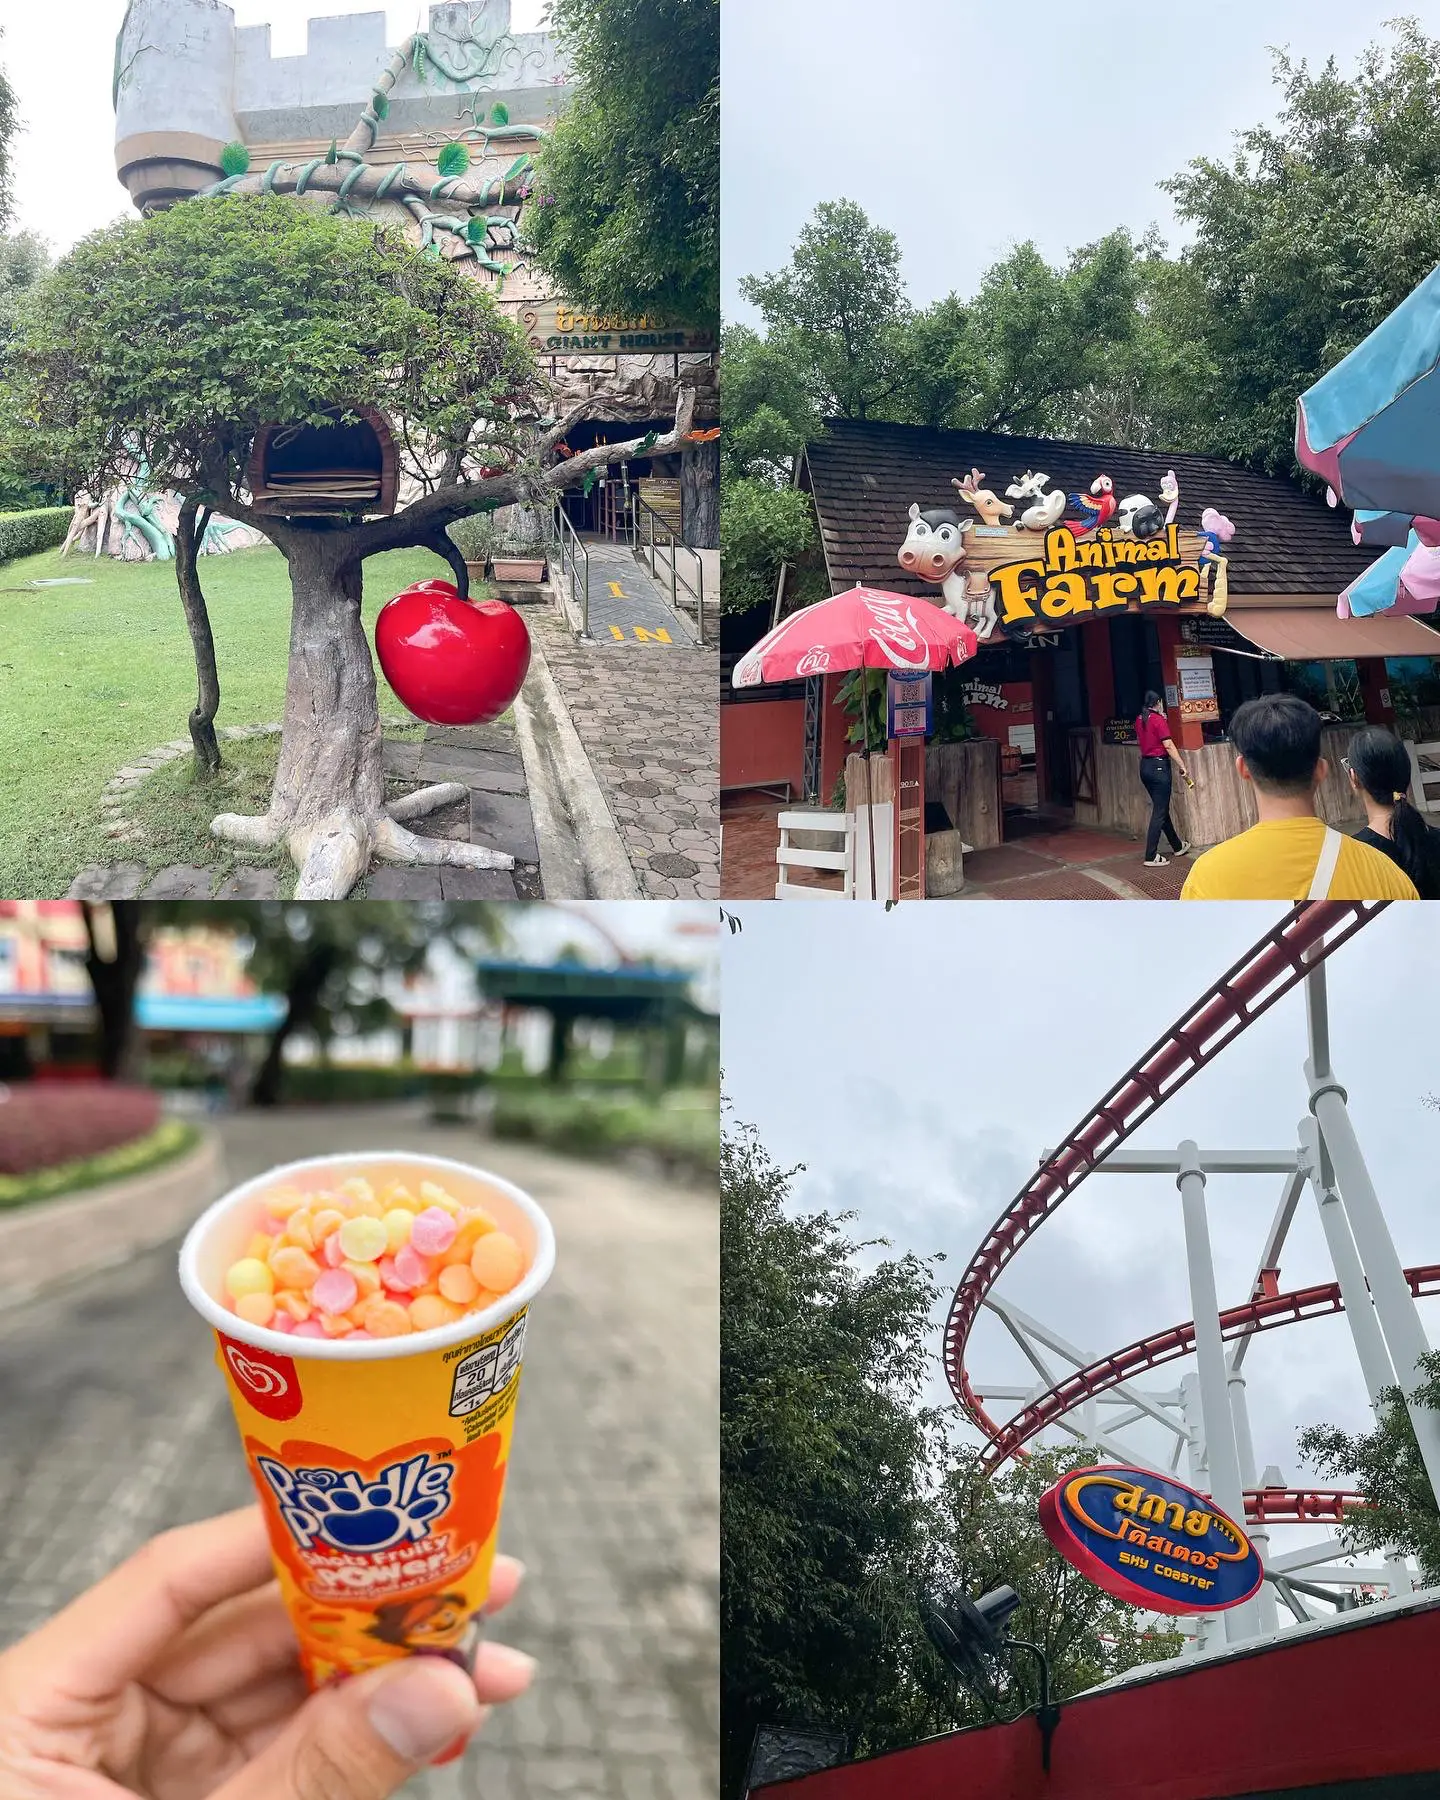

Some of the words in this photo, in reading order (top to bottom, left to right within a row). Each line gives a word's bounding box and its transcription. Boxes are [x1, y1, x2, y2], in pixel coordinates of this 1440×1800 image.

[546, 334, 612, 349] GIANT
[618, 332, 685, 347] HOUSE
[1045, 523, 1180, 572] Animal
[988, 560, 1200, 625] Farm
[608, 624, 673, 644] IN
[1024, 634, 1059, 649] IN
[961, 677, 1002, 695] nimal
[466, 1367, 486, 1387] 20
[257, 1454, 454, 1512] Paddle
[1113, 1484, 1213, 1537] สกาย
[372, 1534, 449, 1566] Fruity
